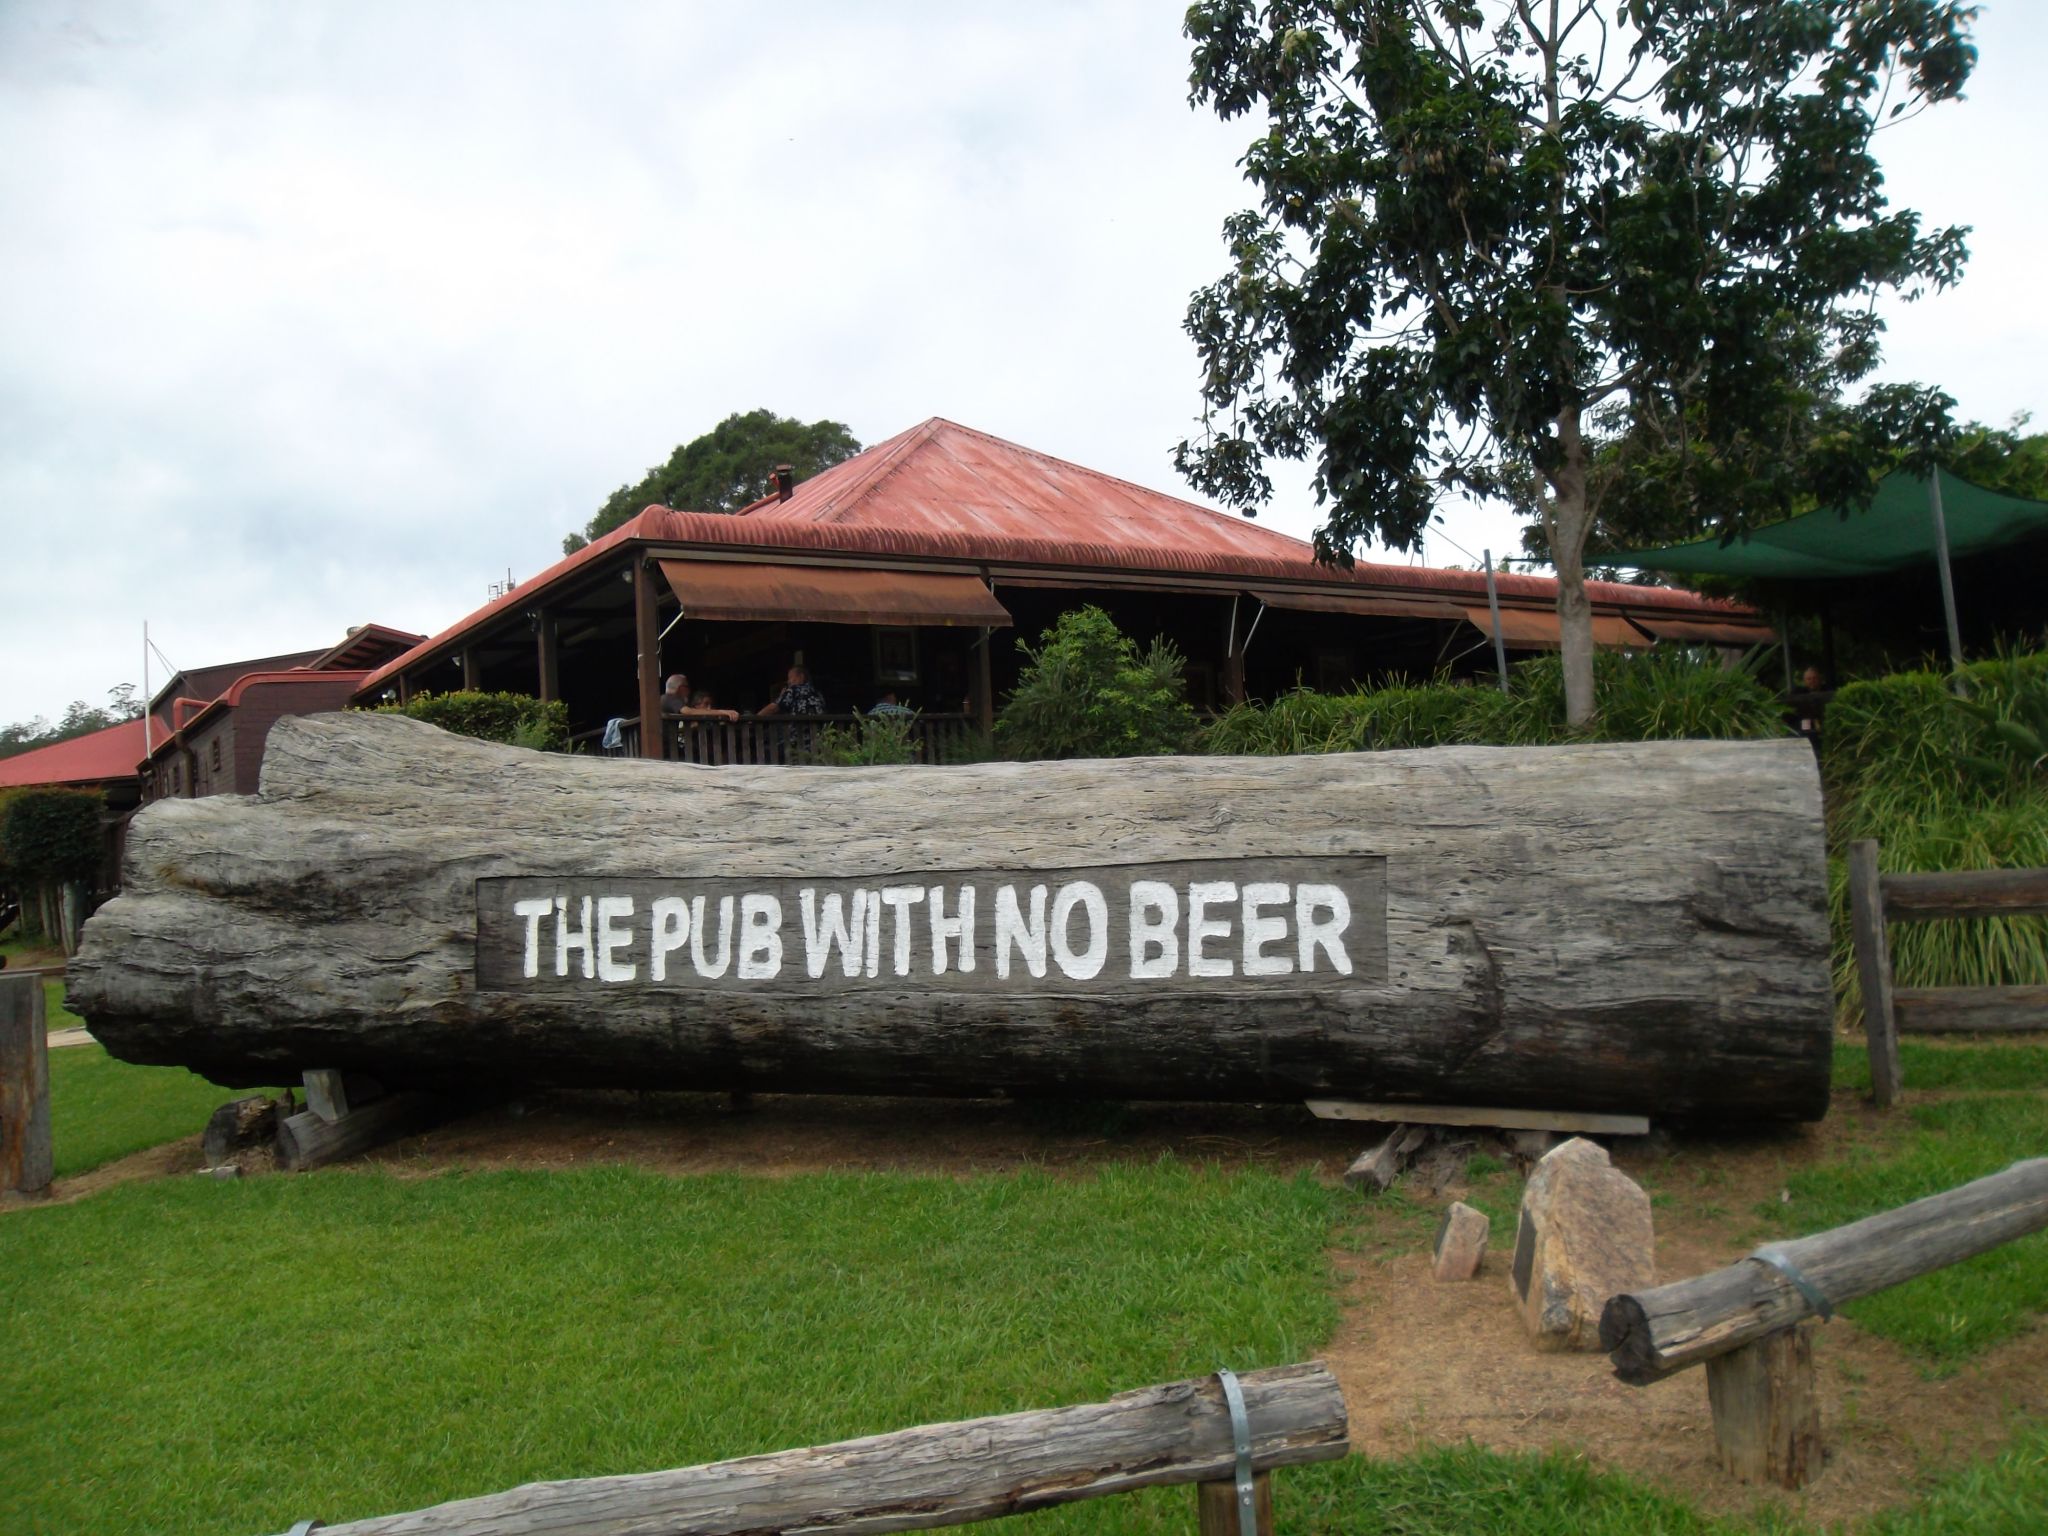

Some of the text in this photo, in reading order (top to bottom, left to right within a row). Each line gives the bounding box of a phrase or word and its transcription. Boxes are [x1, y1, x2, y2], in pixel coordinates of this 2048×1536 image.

[513, 880, 1353, 983] THE PUB WITH NO BEER
